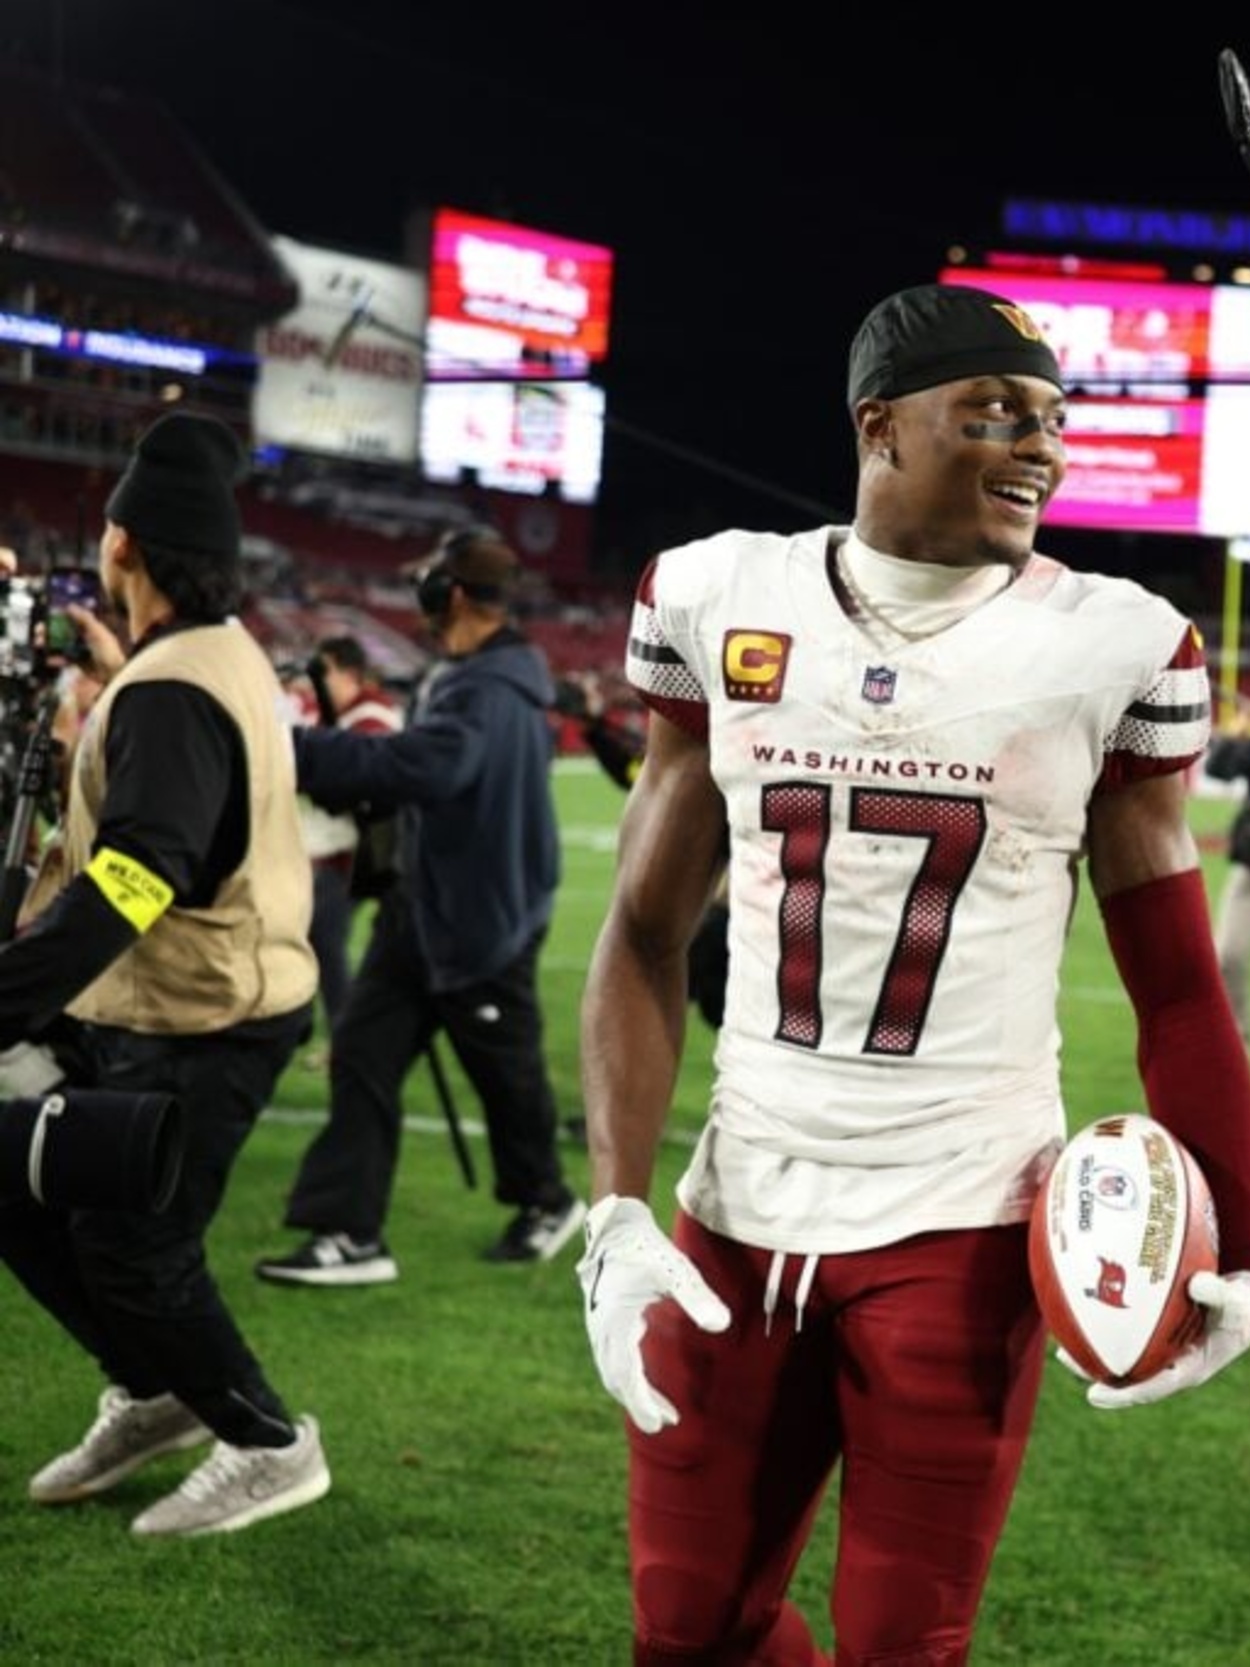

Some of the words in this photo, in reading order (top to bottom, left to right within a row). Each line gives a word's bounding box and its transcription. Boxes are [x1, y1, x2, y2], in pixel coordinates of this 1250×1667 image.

[726, 634, 783, 683] C
[752, 744, 997, 783] WASHINGTON
[761, 781, 987, 1057] 17
